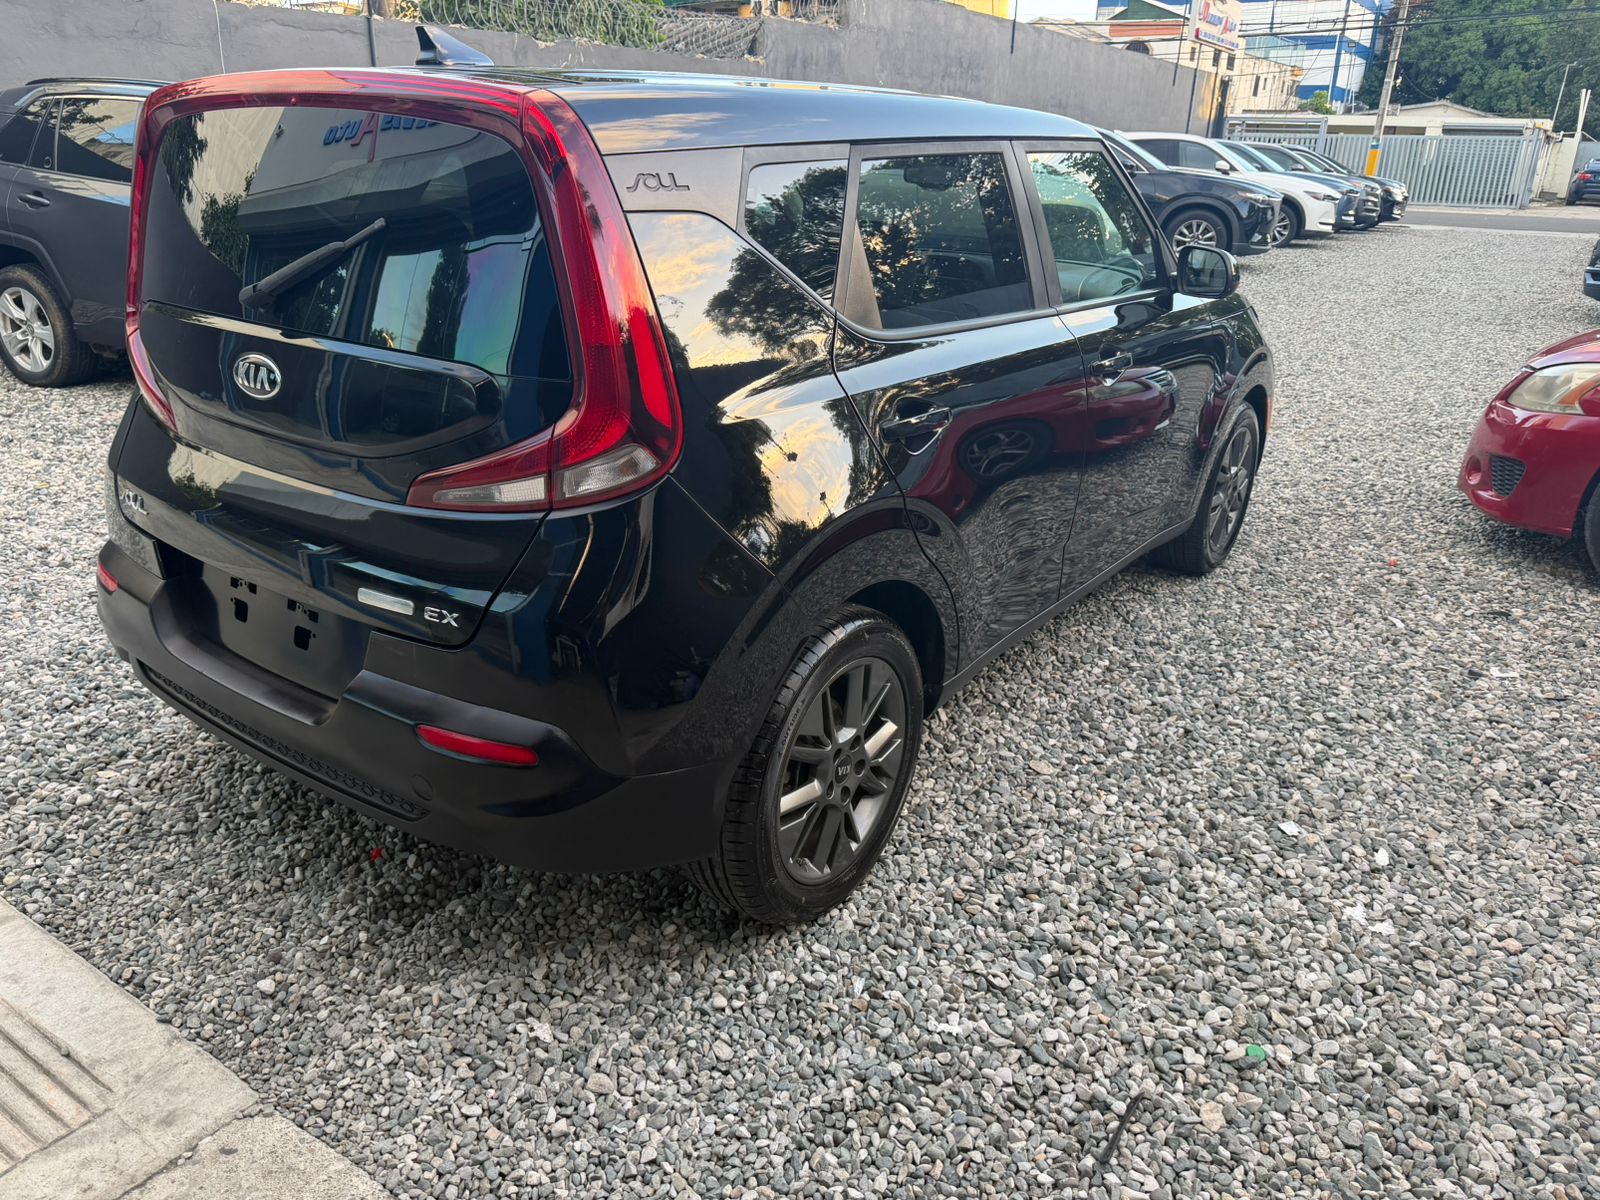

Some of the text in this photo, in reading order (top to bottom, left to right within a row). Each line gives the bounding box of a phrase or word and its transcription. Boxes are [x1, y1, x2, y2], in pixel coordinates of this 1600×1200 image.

[626, 172, 691, 192] SOUL
[237, 360, 271, 392] KIA
[423, 606, 460, 628] EX
